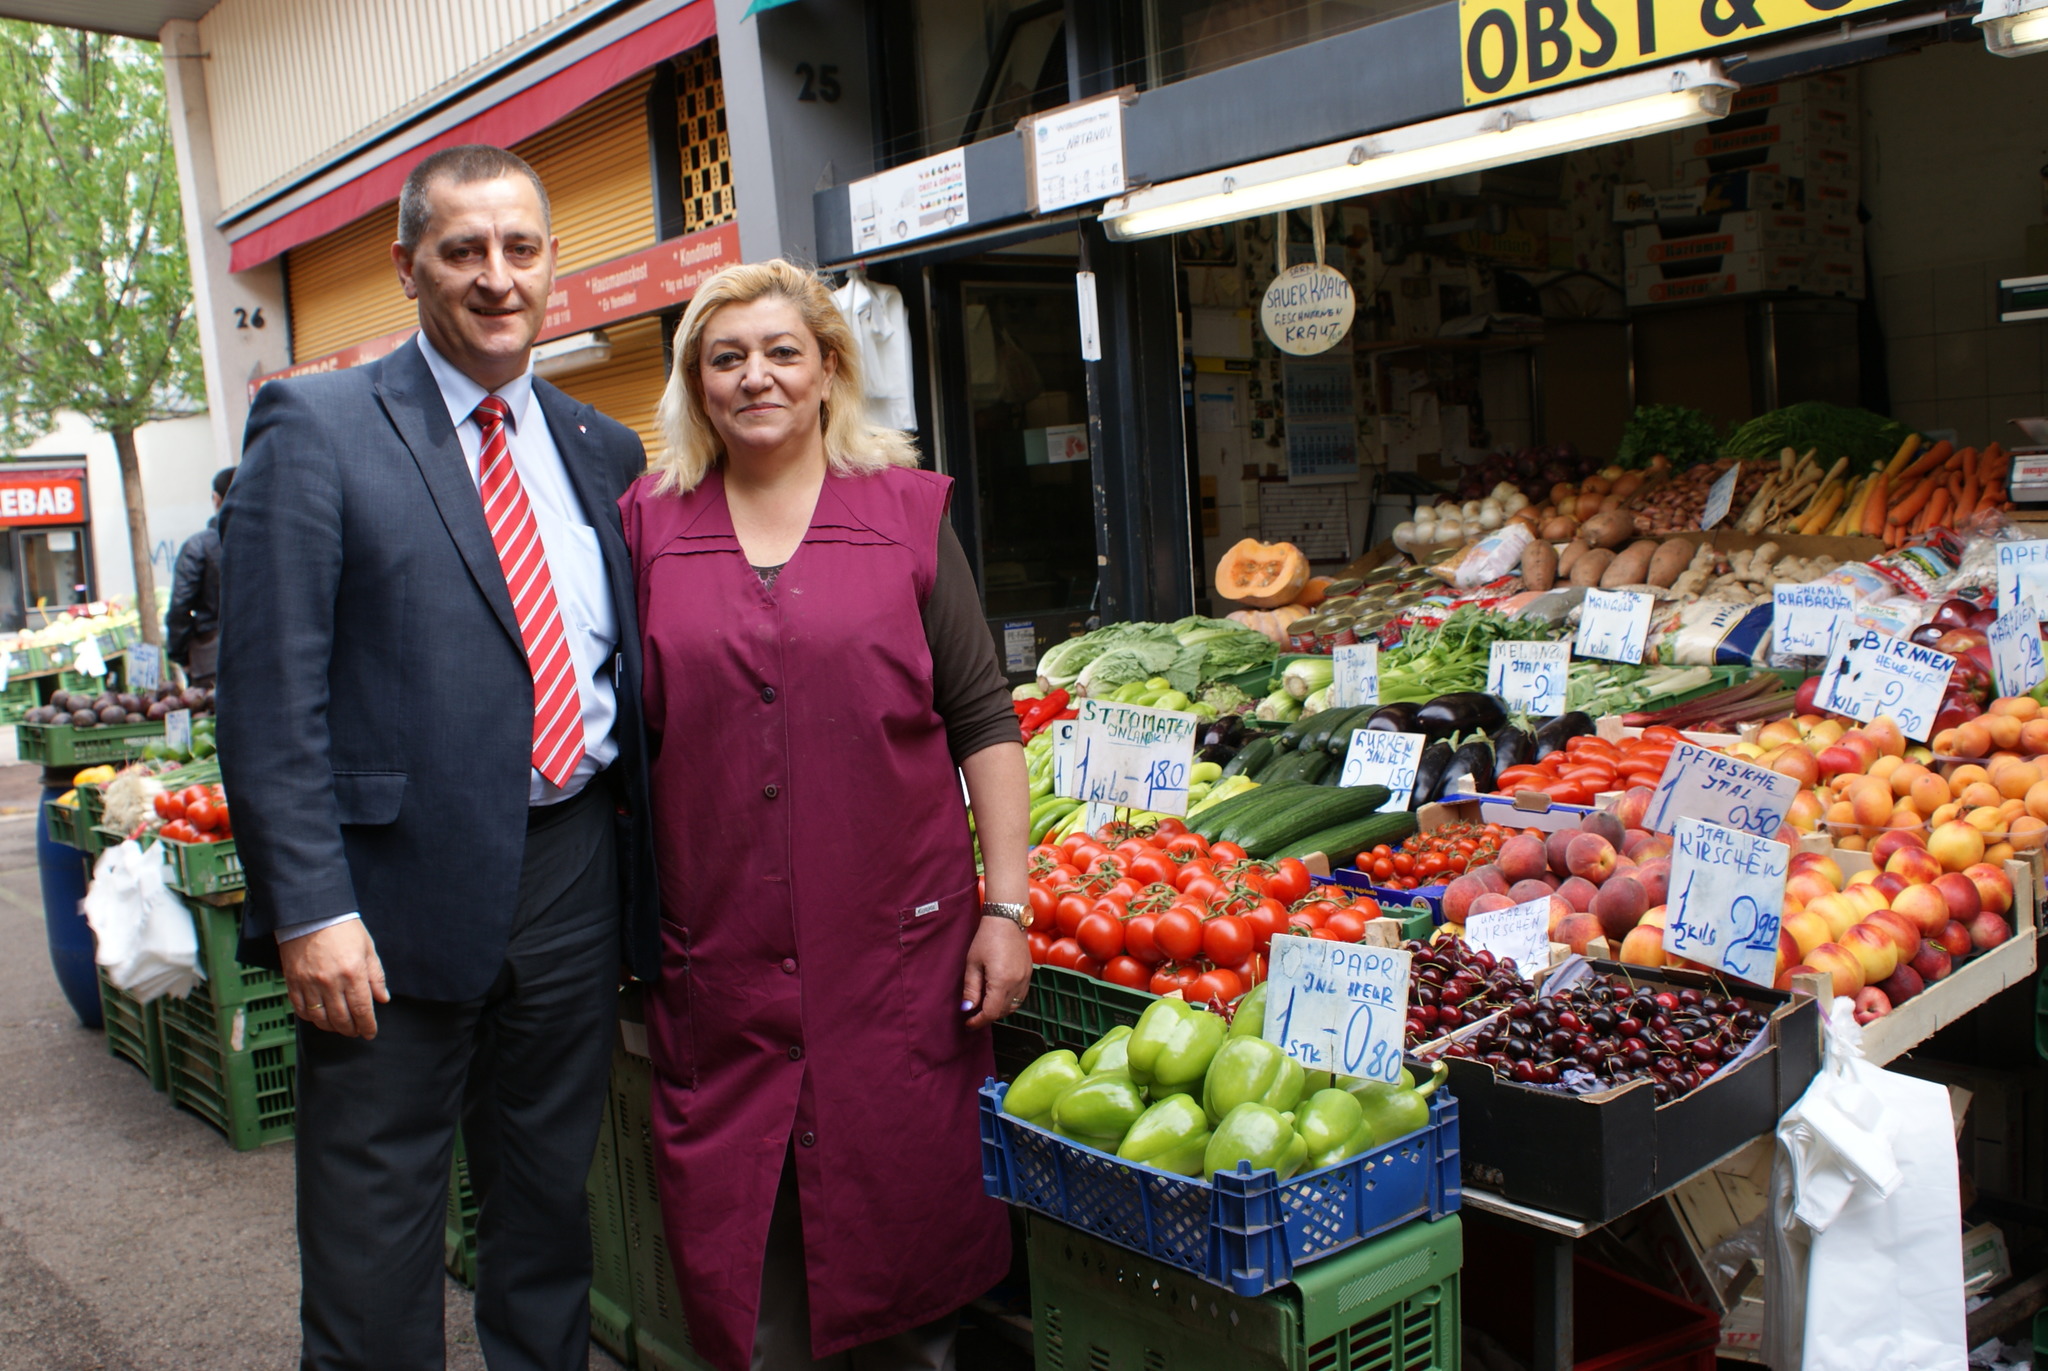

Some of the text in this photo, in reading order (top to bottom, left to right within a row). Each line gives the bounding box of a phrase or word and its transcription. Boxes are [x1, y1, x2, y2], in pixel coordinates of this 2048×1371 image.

[1466, 0, 1657, 94] OBST
[795, 62, 840, 102] 25
[680, 237, 723, 267] Konditorei
[591, 261, 649, 294] Hausmannskost
[234, 307, 265, 328] 26
[1285, 322, 1341, 343] KRAUT
[0, 486, 76, 518] EBAB
[1588, 595, 1635, 613] MANGOLD
[1863, 630, 1957, 673] BIRNNEN
[1677, 745, 1778, 792] PFIRSICHE
[1680, 832, 1787, 878] KIRSCHEN
[1471, 916, 1541, 944] KIRSCHEN
[1287, 1039, 1322, 1064] STK
